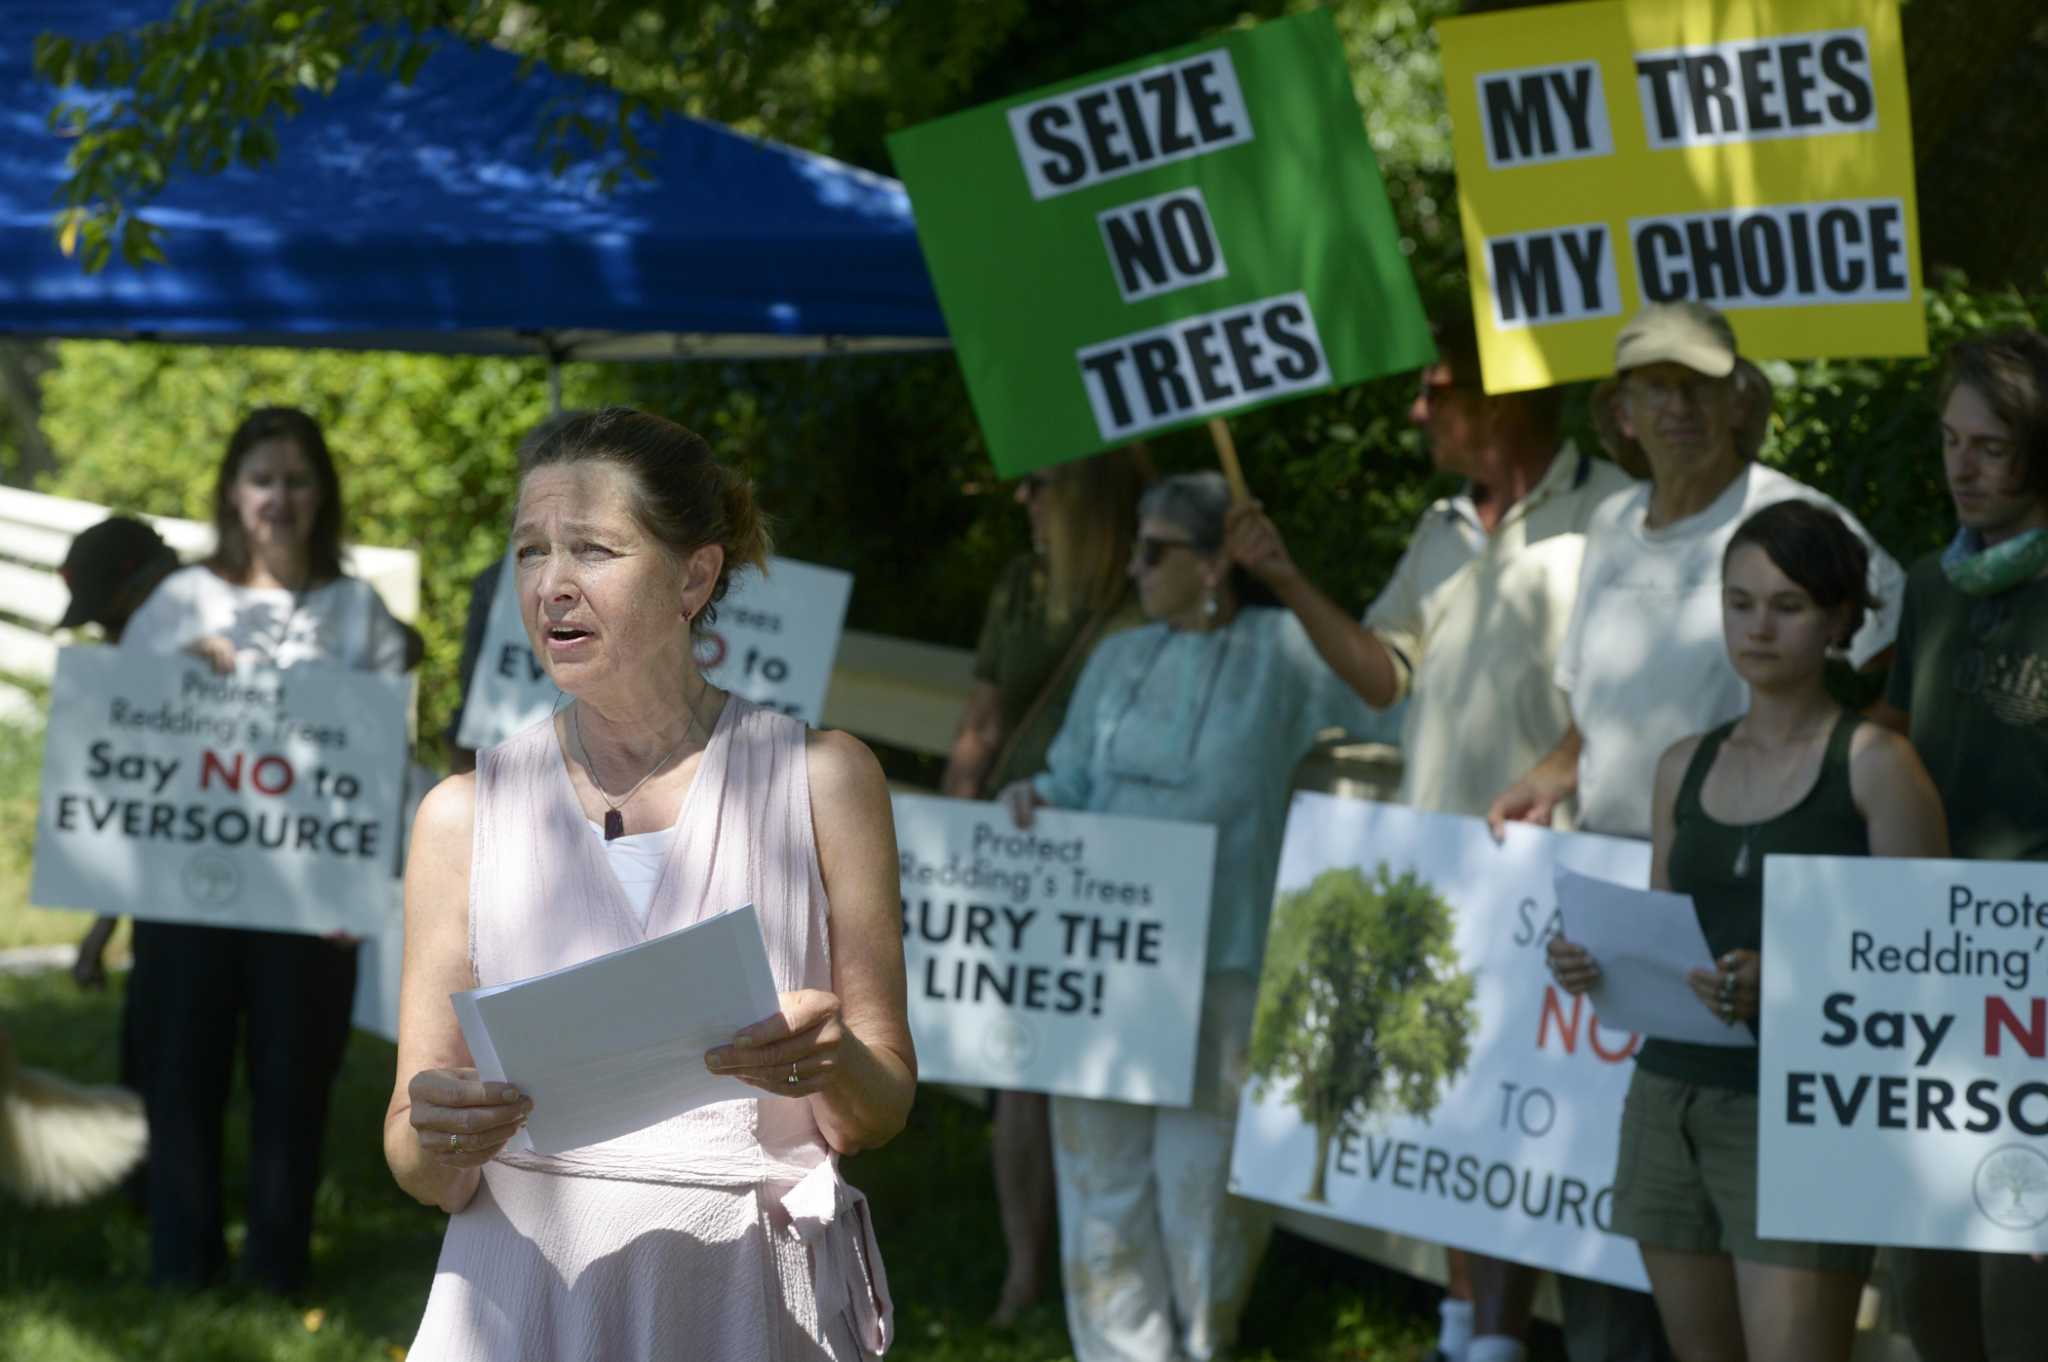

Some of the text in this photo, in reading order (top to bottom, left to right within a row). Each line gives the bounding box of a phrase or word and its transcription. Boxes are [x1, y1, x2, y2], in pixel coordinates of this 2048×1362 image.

[1026, 60, 1237, 186] SEIZE
[1484, 36, 1874, 163] MY TREES
[1105, 197, 1216, 294] NO
[1491, 206, 1905, 321] MY CHOICE
[1083, 302, 1319, 431] TREES
[743, 646, 788, 682] to
[87, 741, 360, 800] Say NO to
[56, 796, 380, 858] EVERSOURCE
[974, 823, 1084, 863] Protect
[1071, 869, 1153, 904] Trees
[1058, 912, 1163, 966] THE
[1850, 929, 2048, 990] Redding'
[925, 956, 1106, 1017] LINES!
[1822, 992, 1956, 1066] Say
[1500, 1081, 1556, 1138] TO
